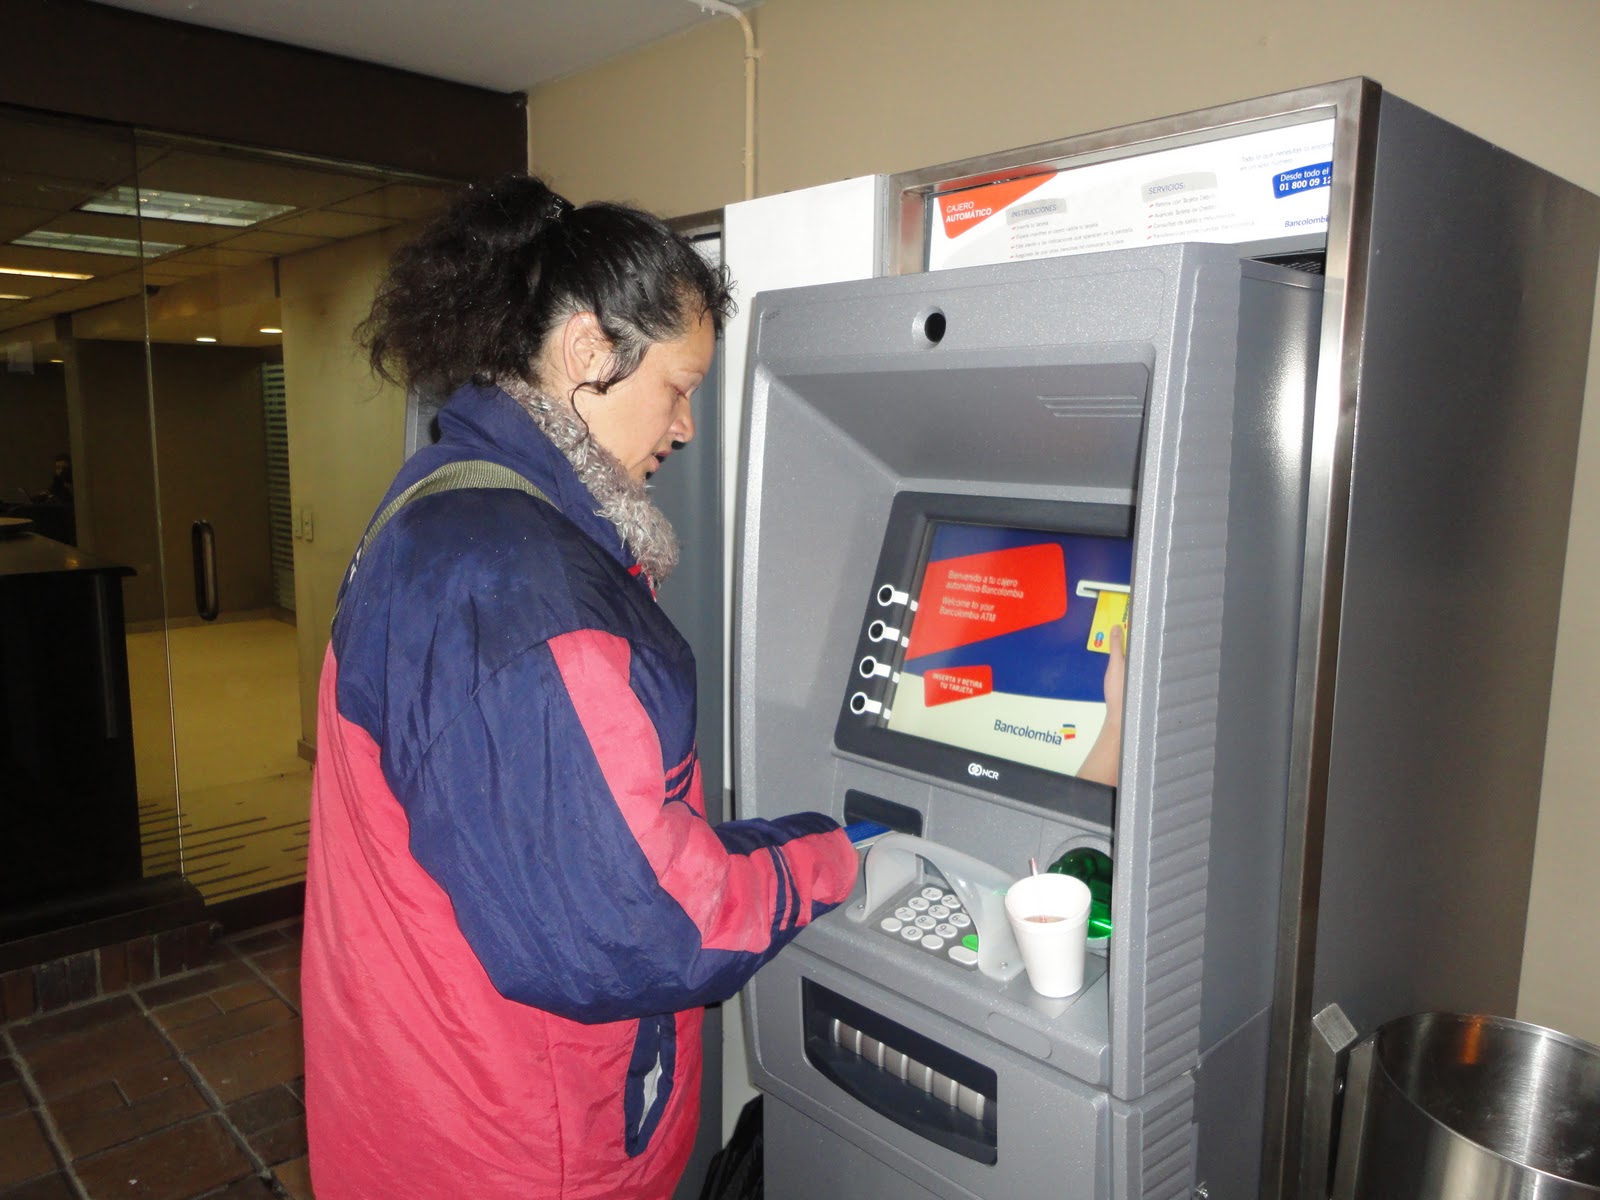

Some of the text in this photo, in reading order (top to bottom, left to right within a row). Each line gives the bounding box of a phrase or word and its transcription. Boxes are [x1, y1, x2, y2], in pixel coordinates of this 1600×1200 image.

[1280, 167, 1329, 182] Desde todo el
[1279, 182, 1290, 191] 01
[1291, 179, 1308, 190] 800
[1309, 177, 1321, 187] 09
[946, 201, 974, 213] CAJERO
[1011, 204, 1057, 218] INSTRUCCIONES
[945, 207, 992, 223] AUTOMÁTICO
[988, 575, 997, 585] tu
[996, 577, 1019, 588] cajero
[981, 584, 1025, 599] Bancolombia
[942, 596, 995, 613] Welcome to your
[939, 606, 997, 623] Bancolombia ATM
[932, 672, 957, 683] INSERTA
[961, 678, 983, 689] RETIRA
[940, 681, 974, 695] TU TARJETA
[994, 719, 1062, 746] Bancolombia
[982, 768, 999, 780] NCR
